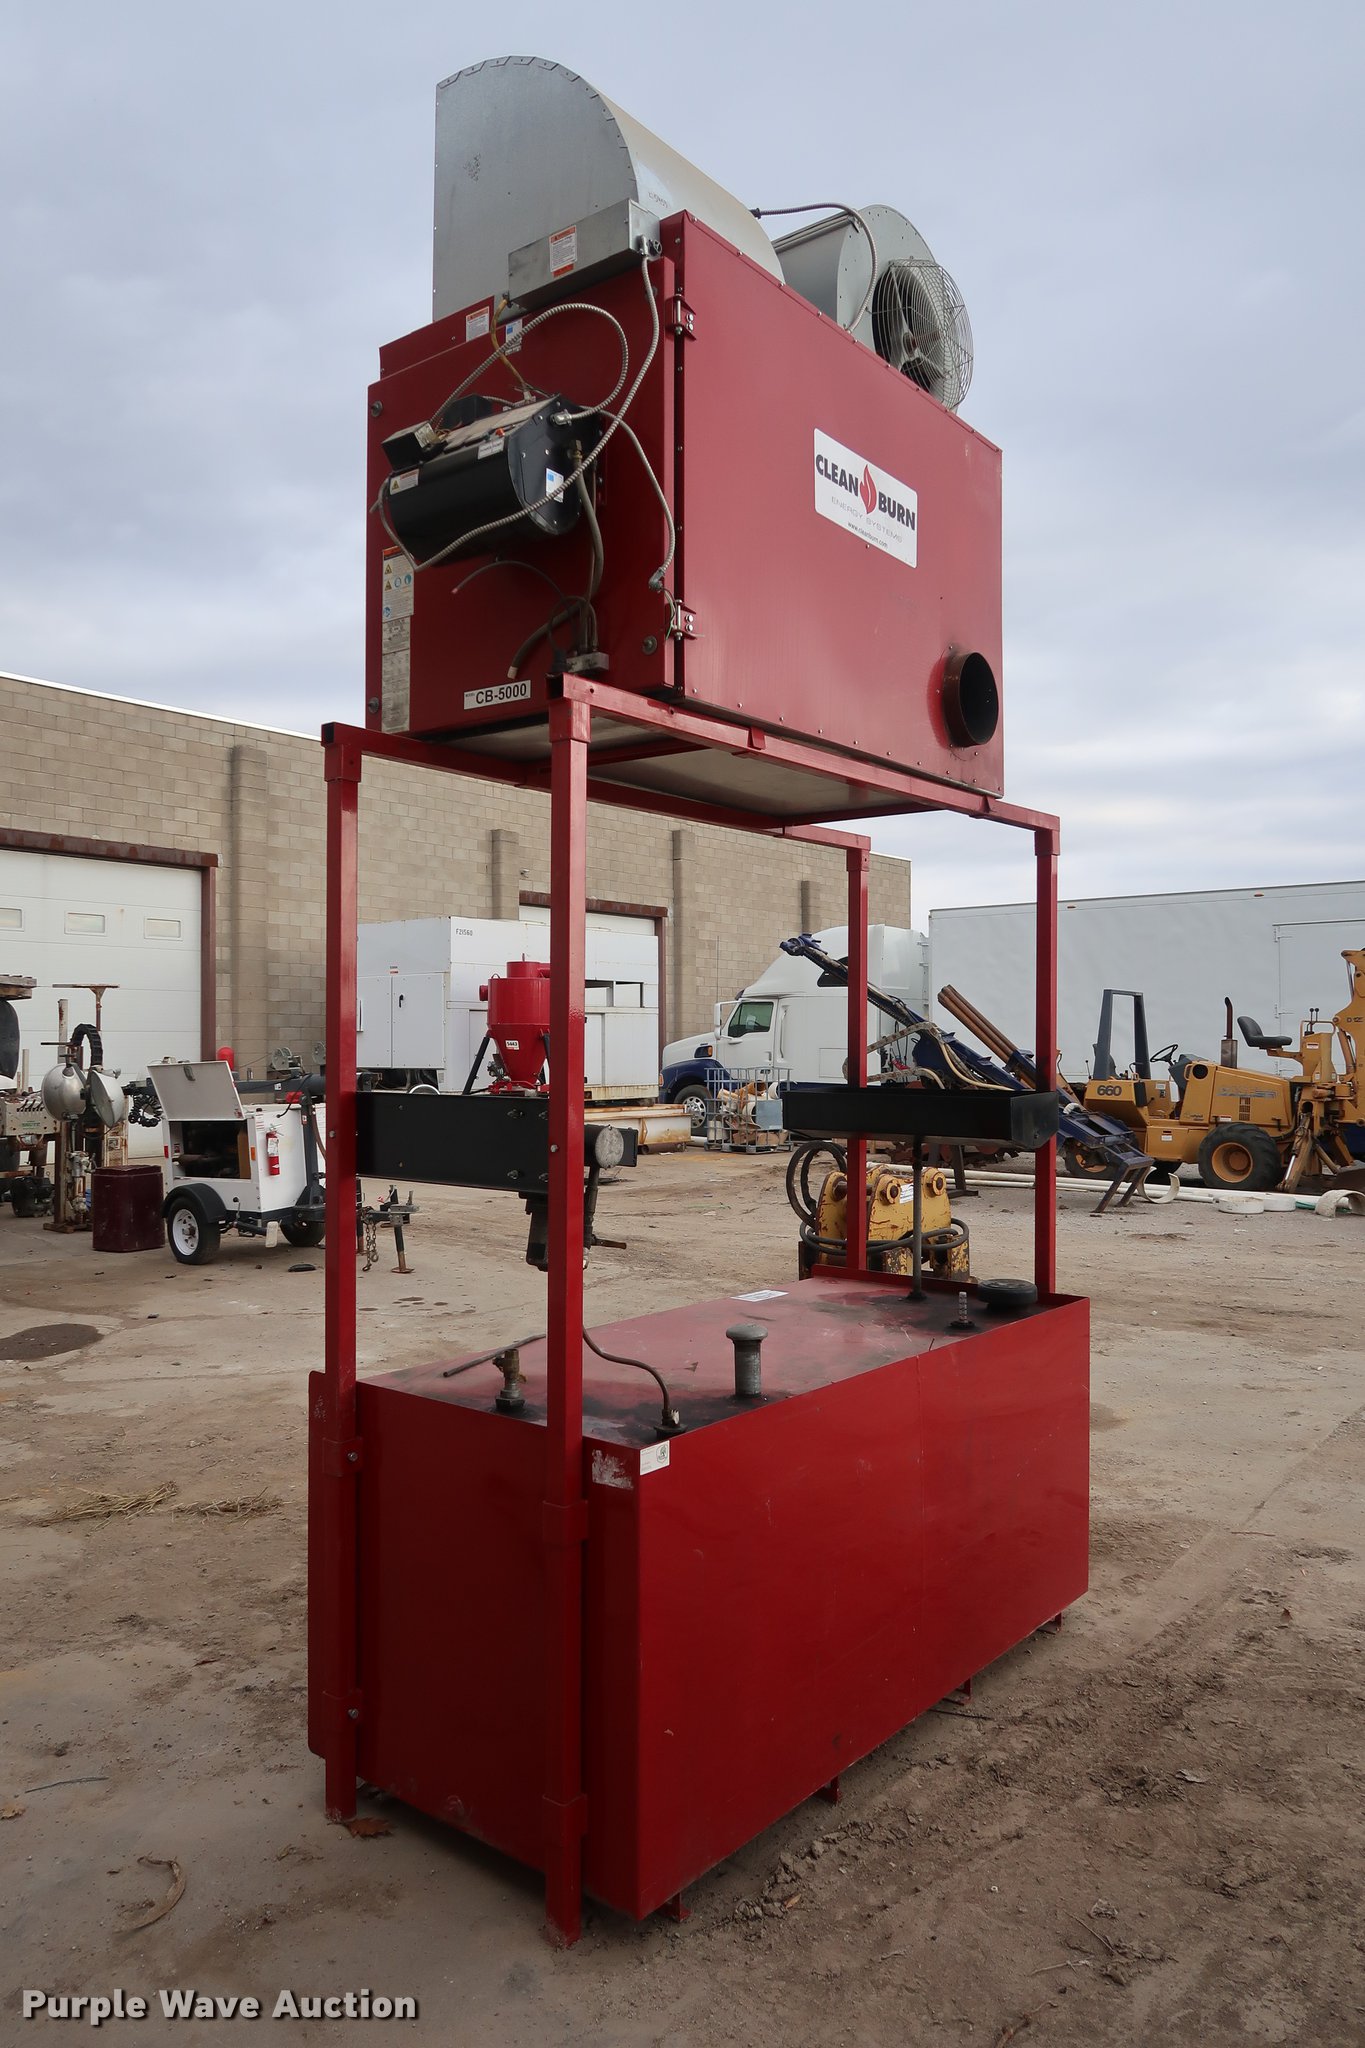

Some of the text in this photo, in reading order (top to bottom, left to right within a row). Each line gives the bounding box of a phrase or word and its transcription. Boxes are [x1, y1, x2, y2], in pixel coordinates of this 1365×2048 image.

[816, 454, 916, 531] CLEAN BURN
[831, 496, 903, 543] ENERGY SYSTEMS
[476, 683, 527, 704] CB-5000
[1097, 1085, 1122, 1096] 660
